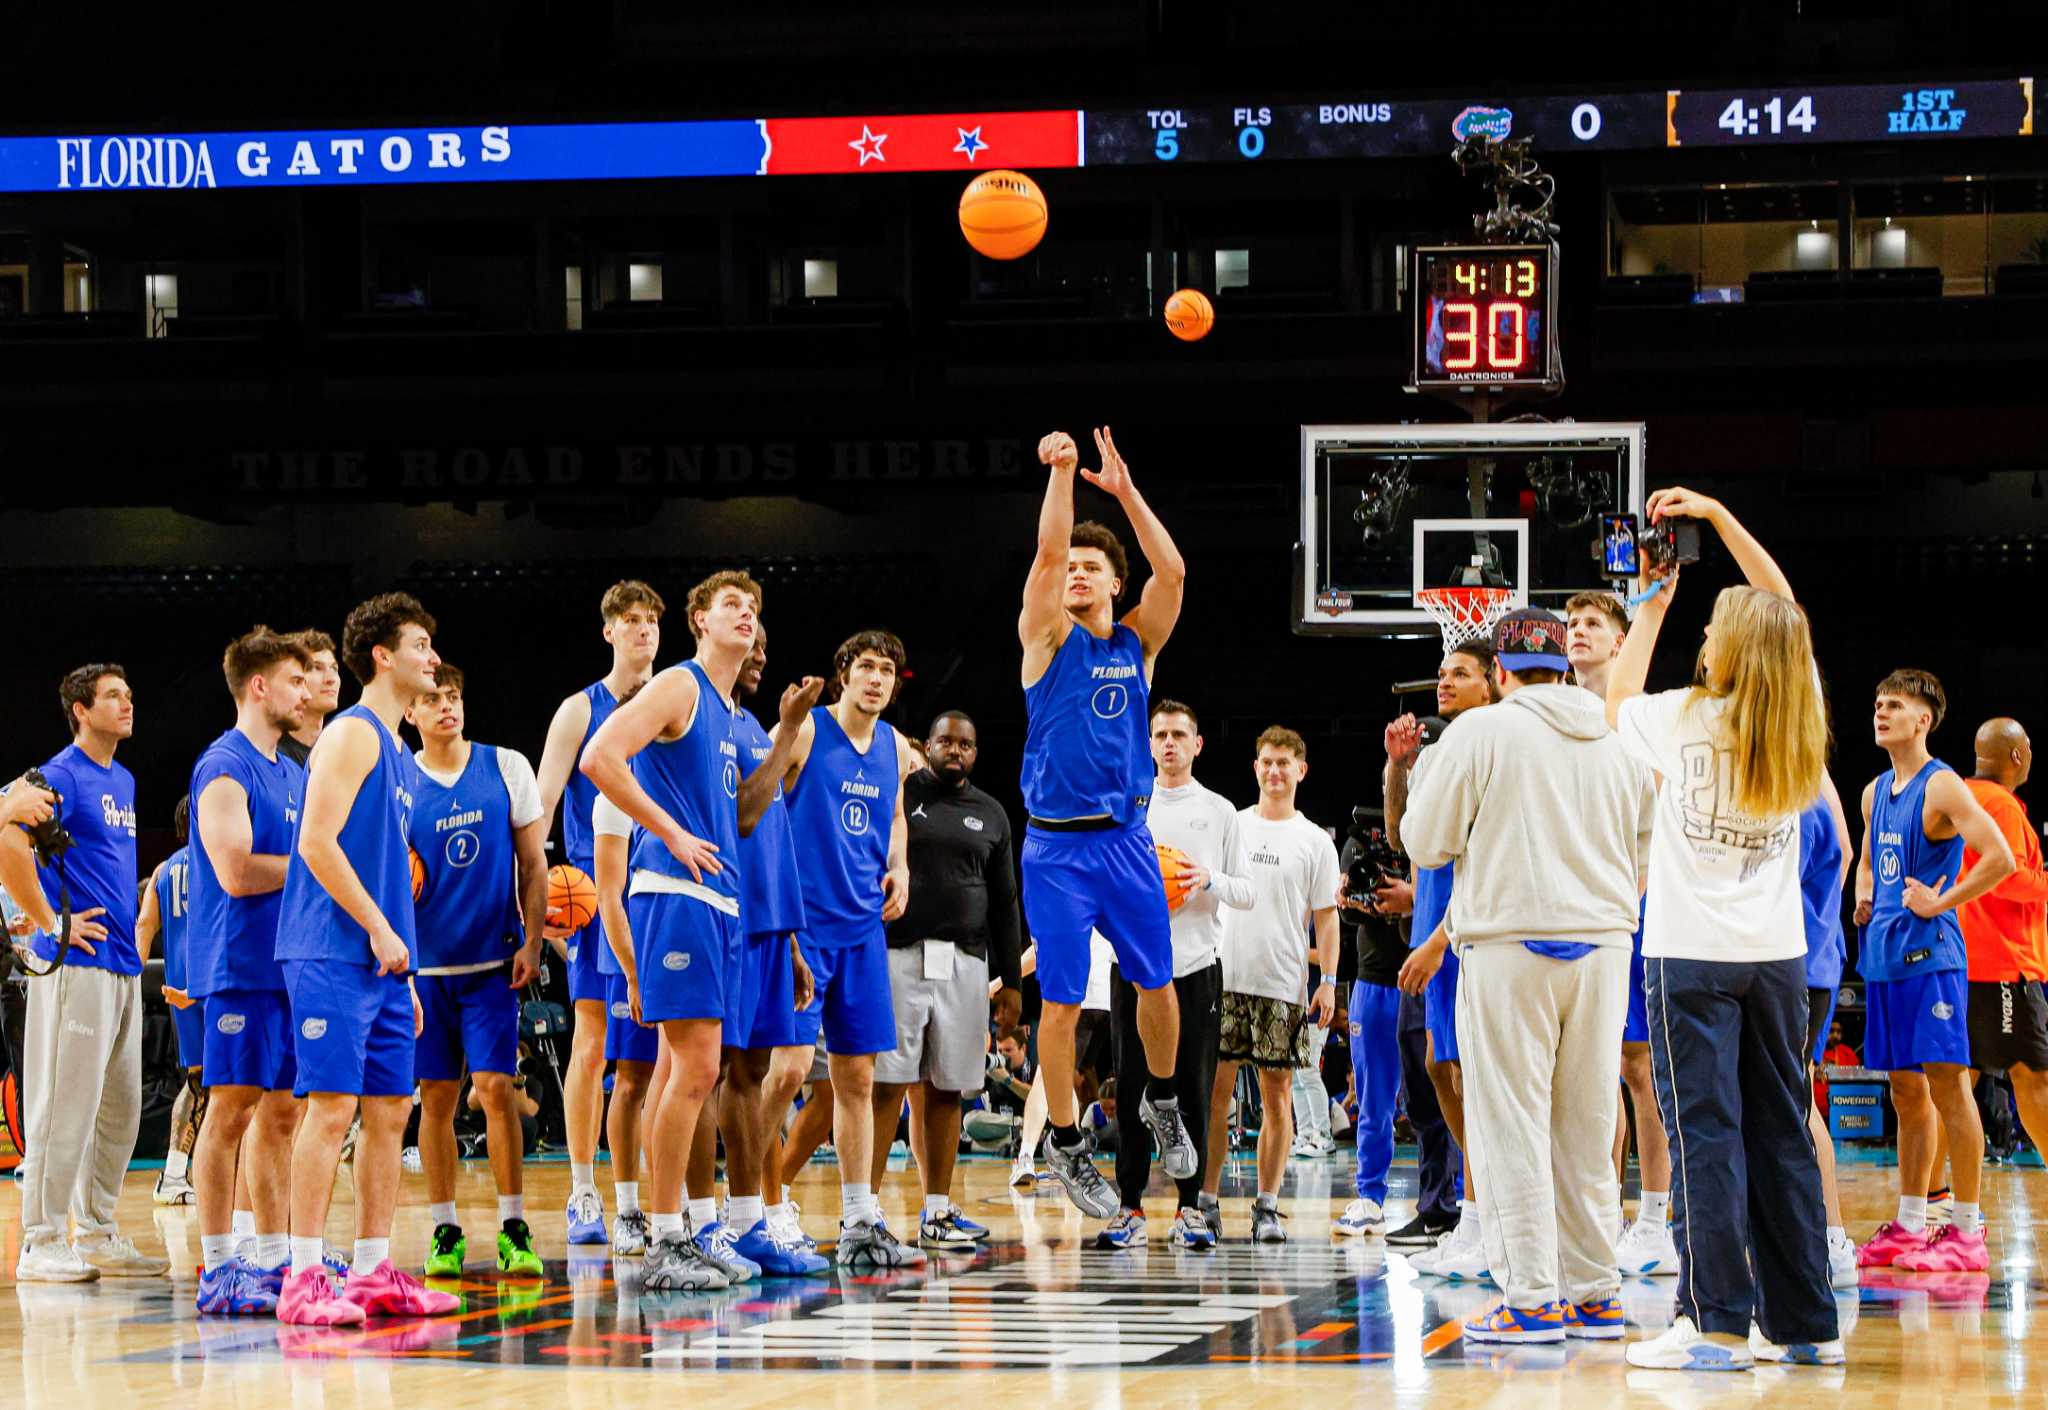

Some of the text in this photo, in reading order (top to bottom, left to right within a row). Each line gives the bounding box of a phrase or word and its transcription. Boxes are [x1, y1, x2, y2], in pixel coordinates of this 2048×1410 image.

[1902, 89, 1954, 111] 1ST
[1147, 104, 1391, 129] TOL FLS BONUS
[1571, 103, 1601, 141] 0
[1718, 96, 1816, 135] 4:14
[1888, 110, 1966, 133] HALF
[1155, 127, 1264, 160] 5 0
[56, 126, 511, 188] FLORIDA GATORS
[1455, 260, 1535, 297] 4:13
[1445, 303, 1523, 368] 30
[1450, 372, 1514, 380] DAKTRONICS
[232, 435, 1023, 491] THE ROAD ENDS HERE
[1091, 664, 1137, 679] FLORIDA
[1109, 690, 1117, 711] 1
[841, 781, 880, 799] FLORIDA
[435, 809, 483, 832] FLORIDA
[849, 806, 863, 827] 12
[457, 837, 467, 859] 2
[1882, 855, 1897, 877] 30
